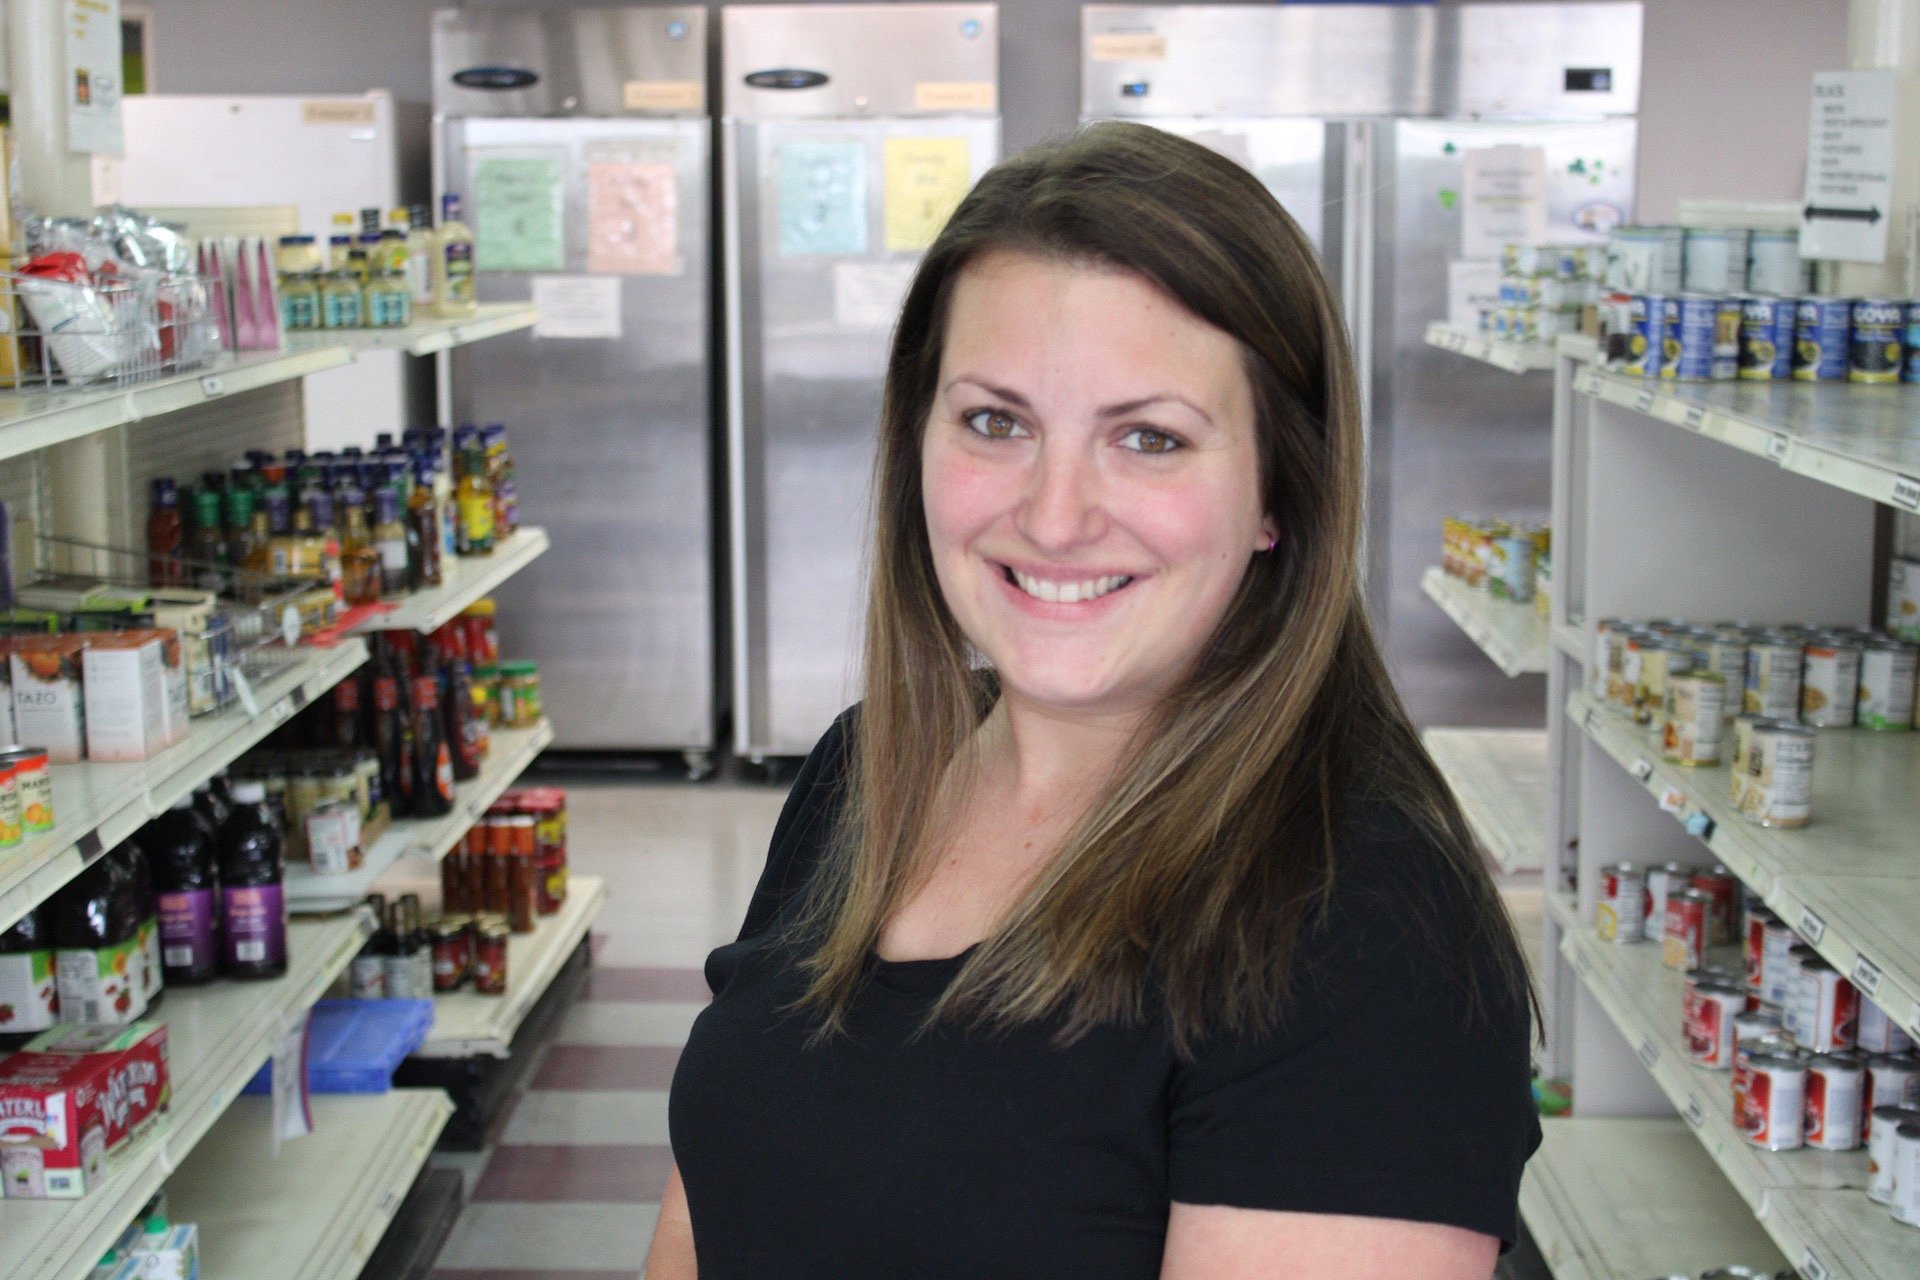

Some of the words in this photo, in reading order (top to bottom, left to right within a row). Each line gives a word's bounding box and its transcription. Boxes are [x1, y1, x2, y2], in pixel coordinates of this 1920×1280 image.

[1852, 306, 1900, 323] GOYA
[17, 690, 57, 705] TAZO
[0, 1098, 47, 1119] ATERL
